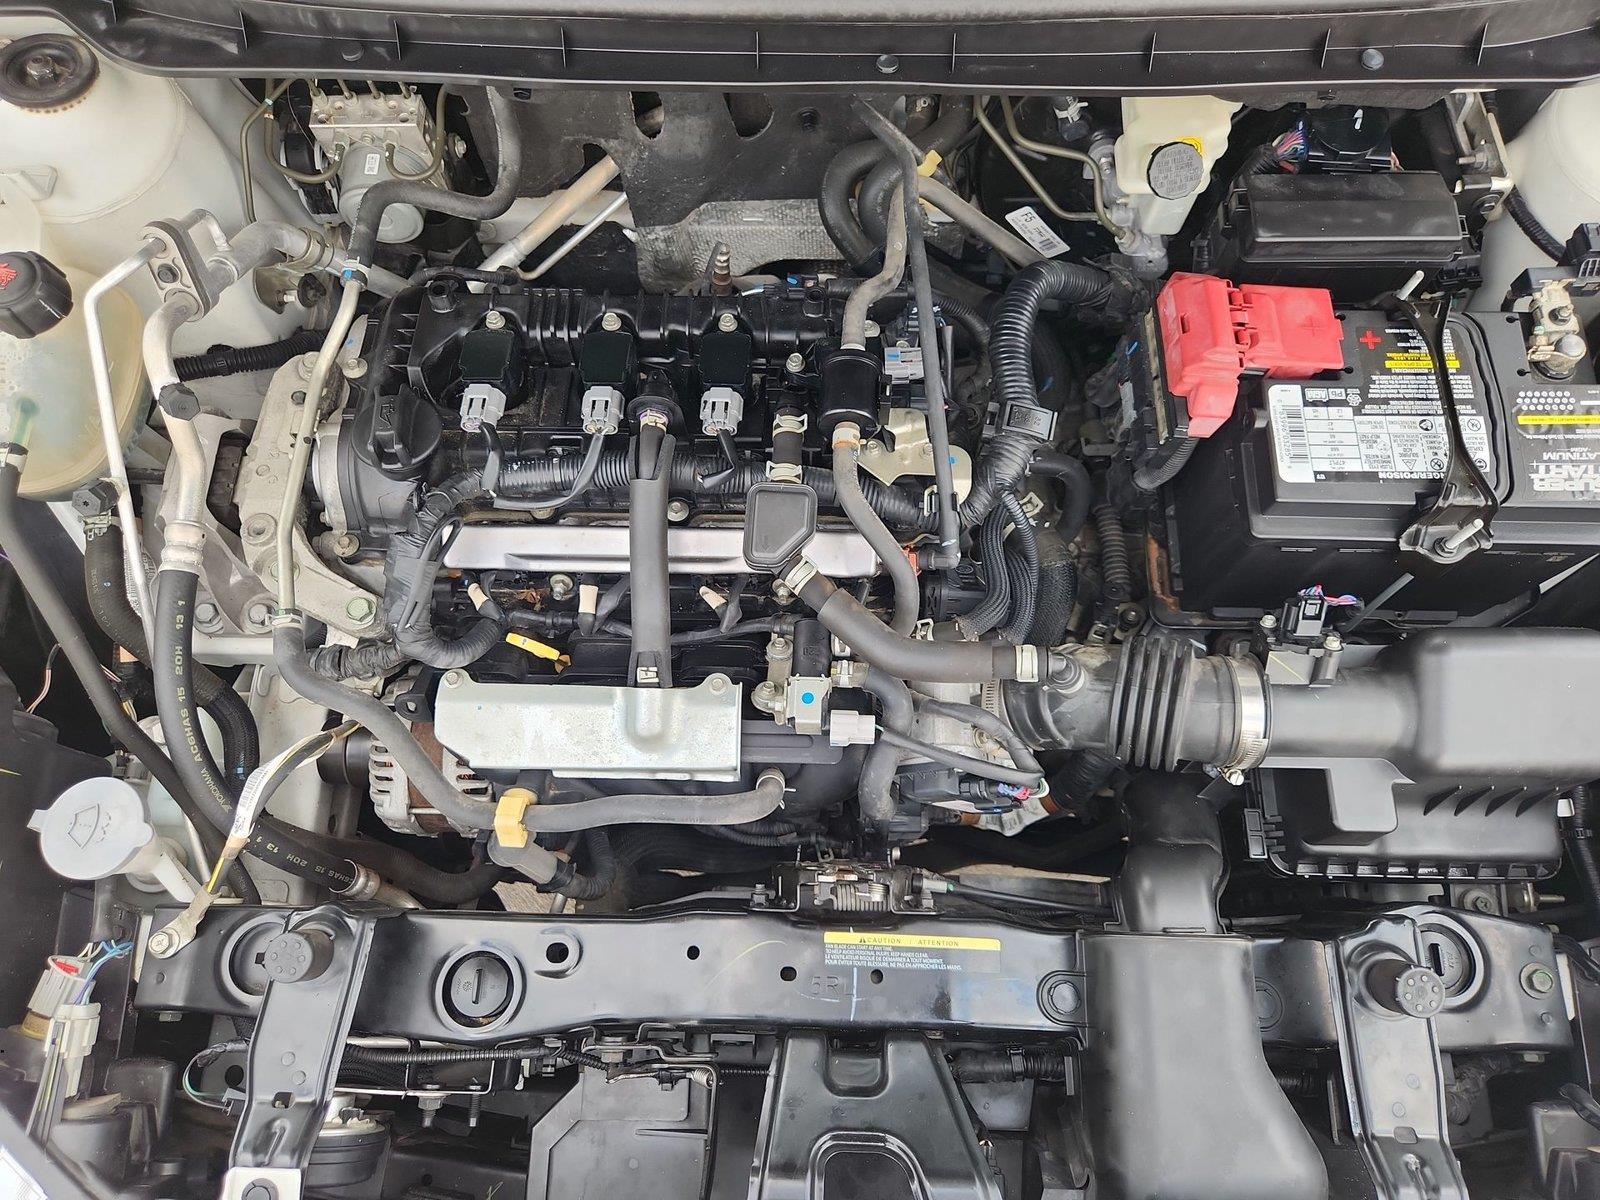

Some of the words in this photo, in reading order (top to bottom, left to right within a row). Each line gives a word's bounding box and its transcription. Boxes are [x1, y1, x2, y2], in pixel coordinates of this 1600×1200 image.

[1021, 212, 1035, 223] F5
[1529, 464, 1600, 479] TART
[175, 615, 184, 630] 13
[174, 646, 183, 675] 20H
[176, 686, 186, 702] 15
[200, 767, 226, 805] YOKOHAMA
[266, 842, 279, 854] 13
[286, 853, 308, 867] 20H
[314, 865, 326, 874] 15
